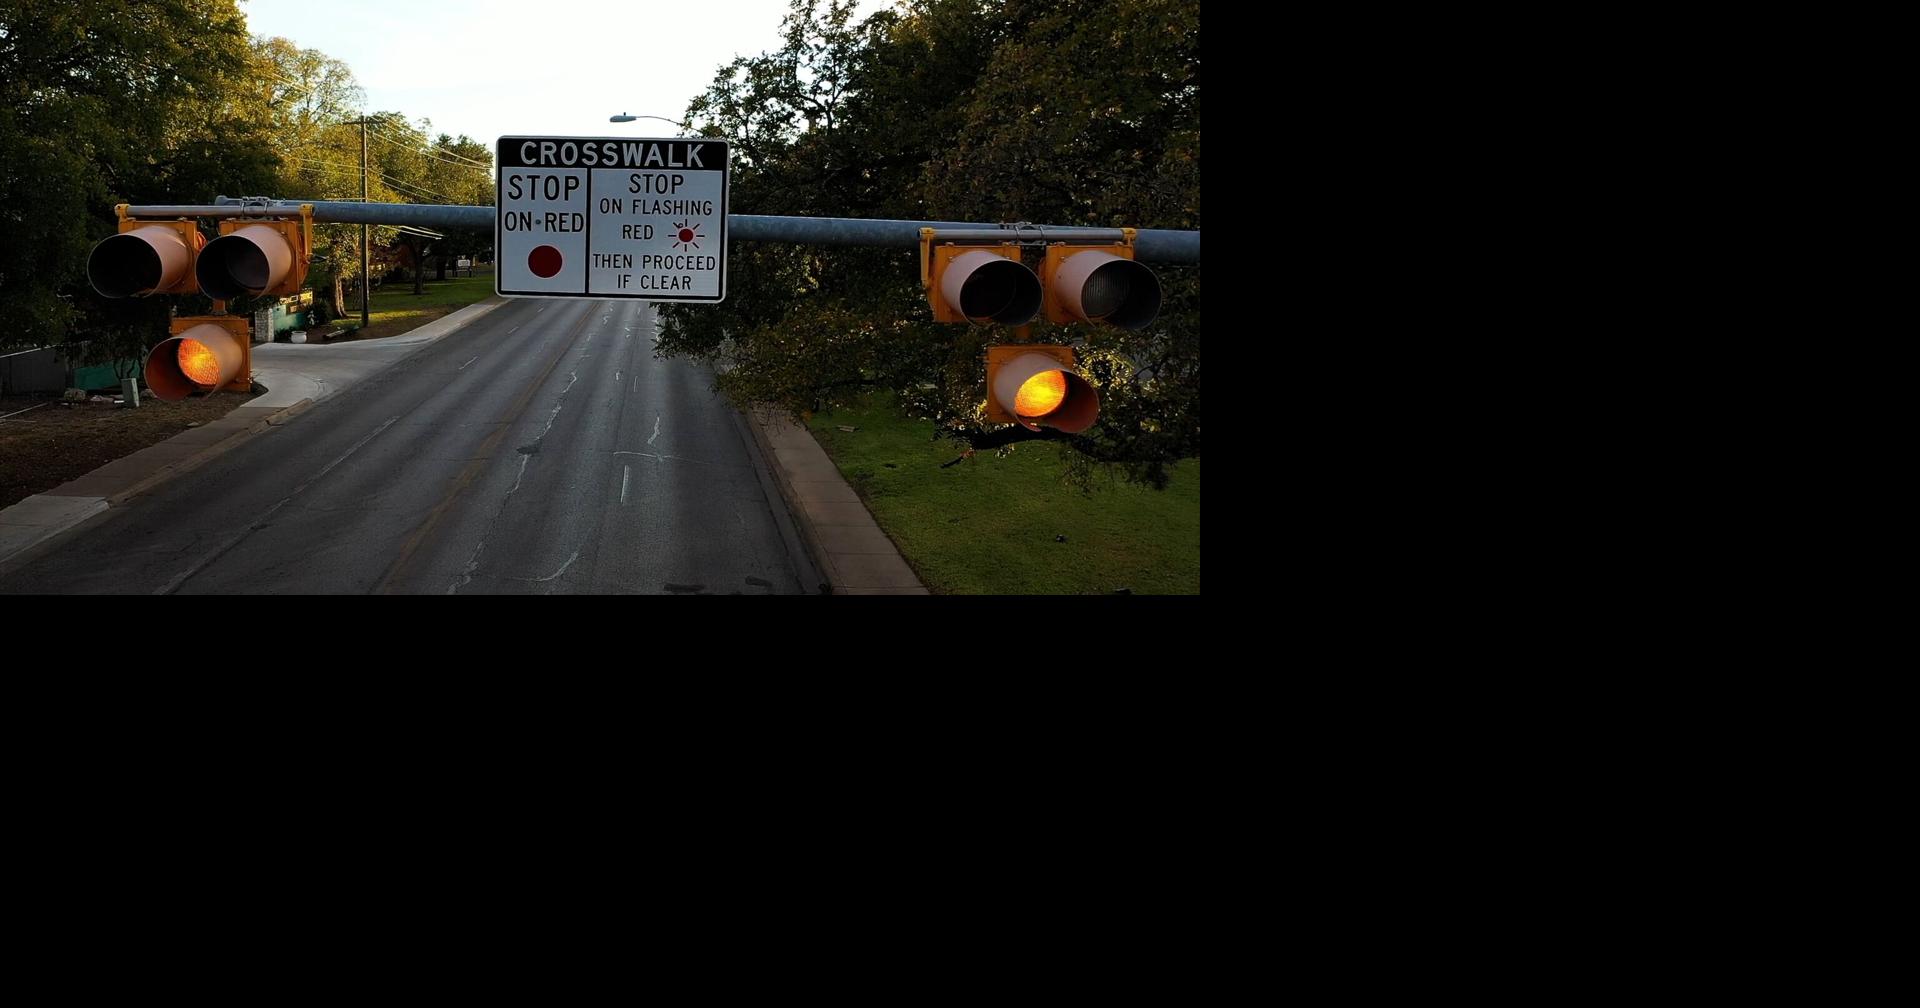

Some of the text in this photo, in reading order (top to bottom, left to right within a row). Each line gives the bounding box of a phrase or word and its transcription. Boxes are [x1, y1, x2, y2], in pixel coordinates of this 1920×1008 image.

[520, 141, 704, 168] CROSSWALK
[508, 174, 579, 201] STOP
[628, 173, 684, 194] STOP
[600, 198, 713, 215] ON FLASHING
[504, 211, 584, 232] ON RED
[622, 224, 654, 240] RED
[593, 253, 716, 270] THEN PROCEED
[617, 274, 691, 290] IF CLEAR
